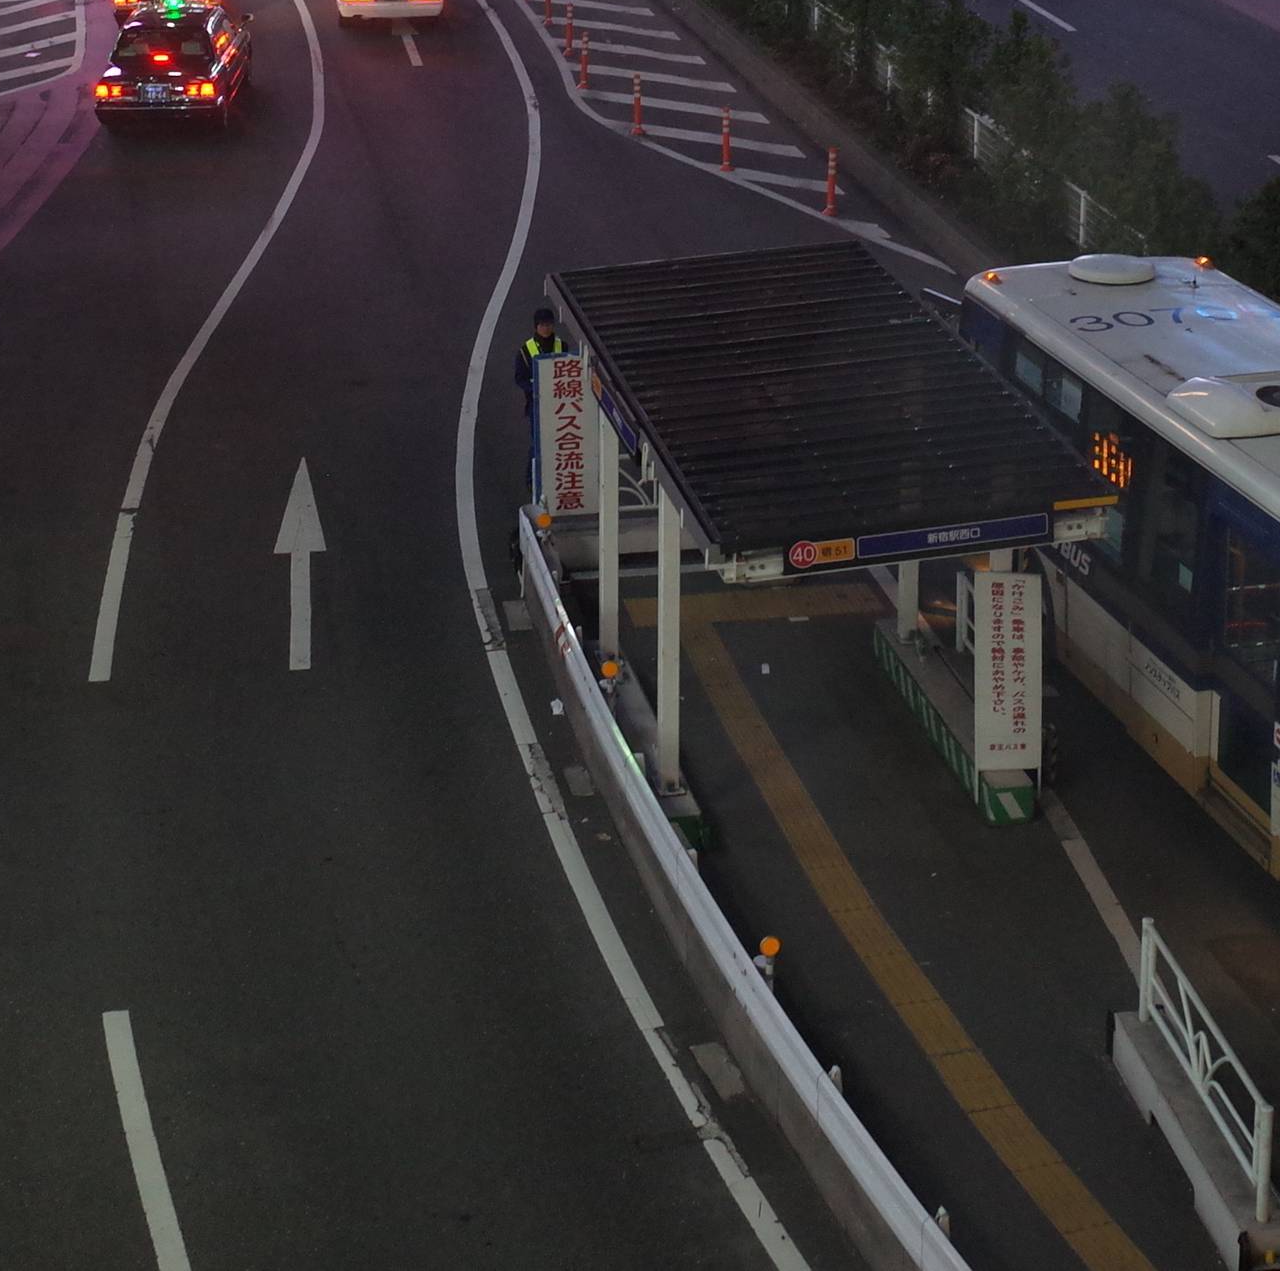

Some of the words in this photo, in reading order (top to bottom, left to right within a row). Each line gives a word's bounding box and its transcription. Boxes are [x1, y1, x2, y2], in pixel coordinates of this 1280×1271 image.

[553, 359, 585, 511] 路線バス合流注意
[927, 527, 981, 545] 新宿駅西口
[792, 547, 815, 563] 40
[1059, 542, 1092, 576] BUS
